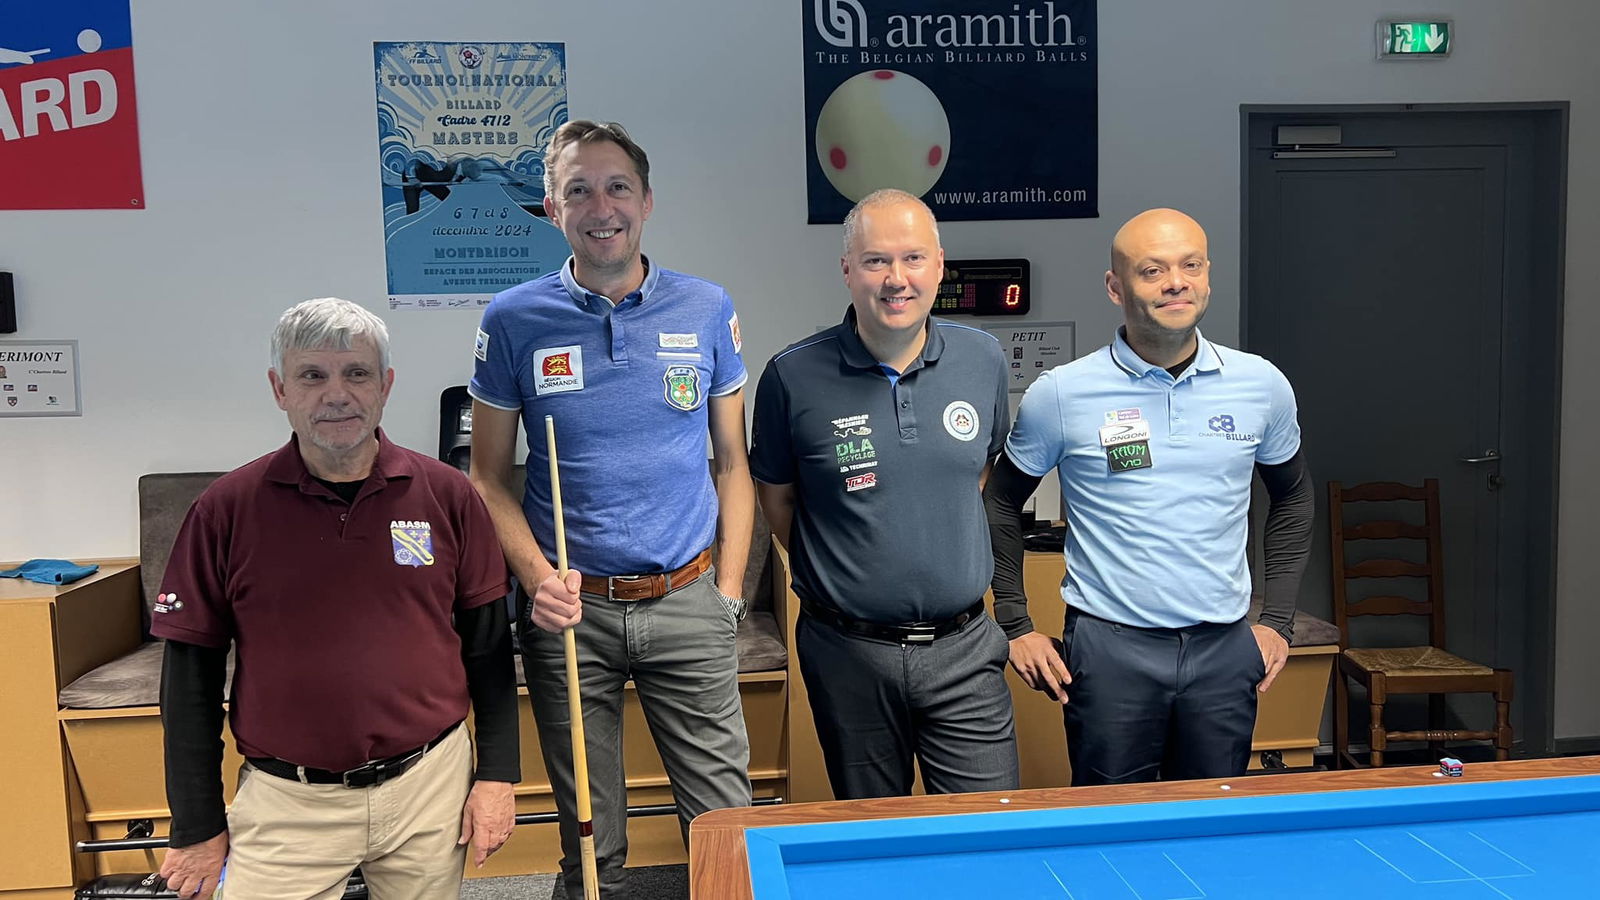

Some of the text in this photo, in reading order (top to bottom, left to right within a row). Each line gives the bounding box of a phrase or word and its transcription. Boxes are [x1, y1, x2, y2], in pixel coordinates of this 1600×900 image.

[886, 1, 1075, 48] aramith
[387, 74, 556, 87] TOURNOI NATIONAL
[446, 100, 502, 111] BILLARD
[437, 114, 477, 126] Cadre
[433, 132, 518, 145] MASTERS
[934, 187, 1087, 204] www.aramith.com
[453, 208, 462, 219] 6
[471, 208, 479, 219] 7
[500, 208, 509, 219] 8
[495, 224, 531, 237] 2024
[1005, 284, 1020, 305] 0
[1012, 331, 1046, 342] PETIT
[539, 379, 578, 389] NORMANDIE
[1104, 432, 1147, 443] LONGONI
[835, 438, 874, 456] DLA
[390, 520, 431, 530] ABASM
